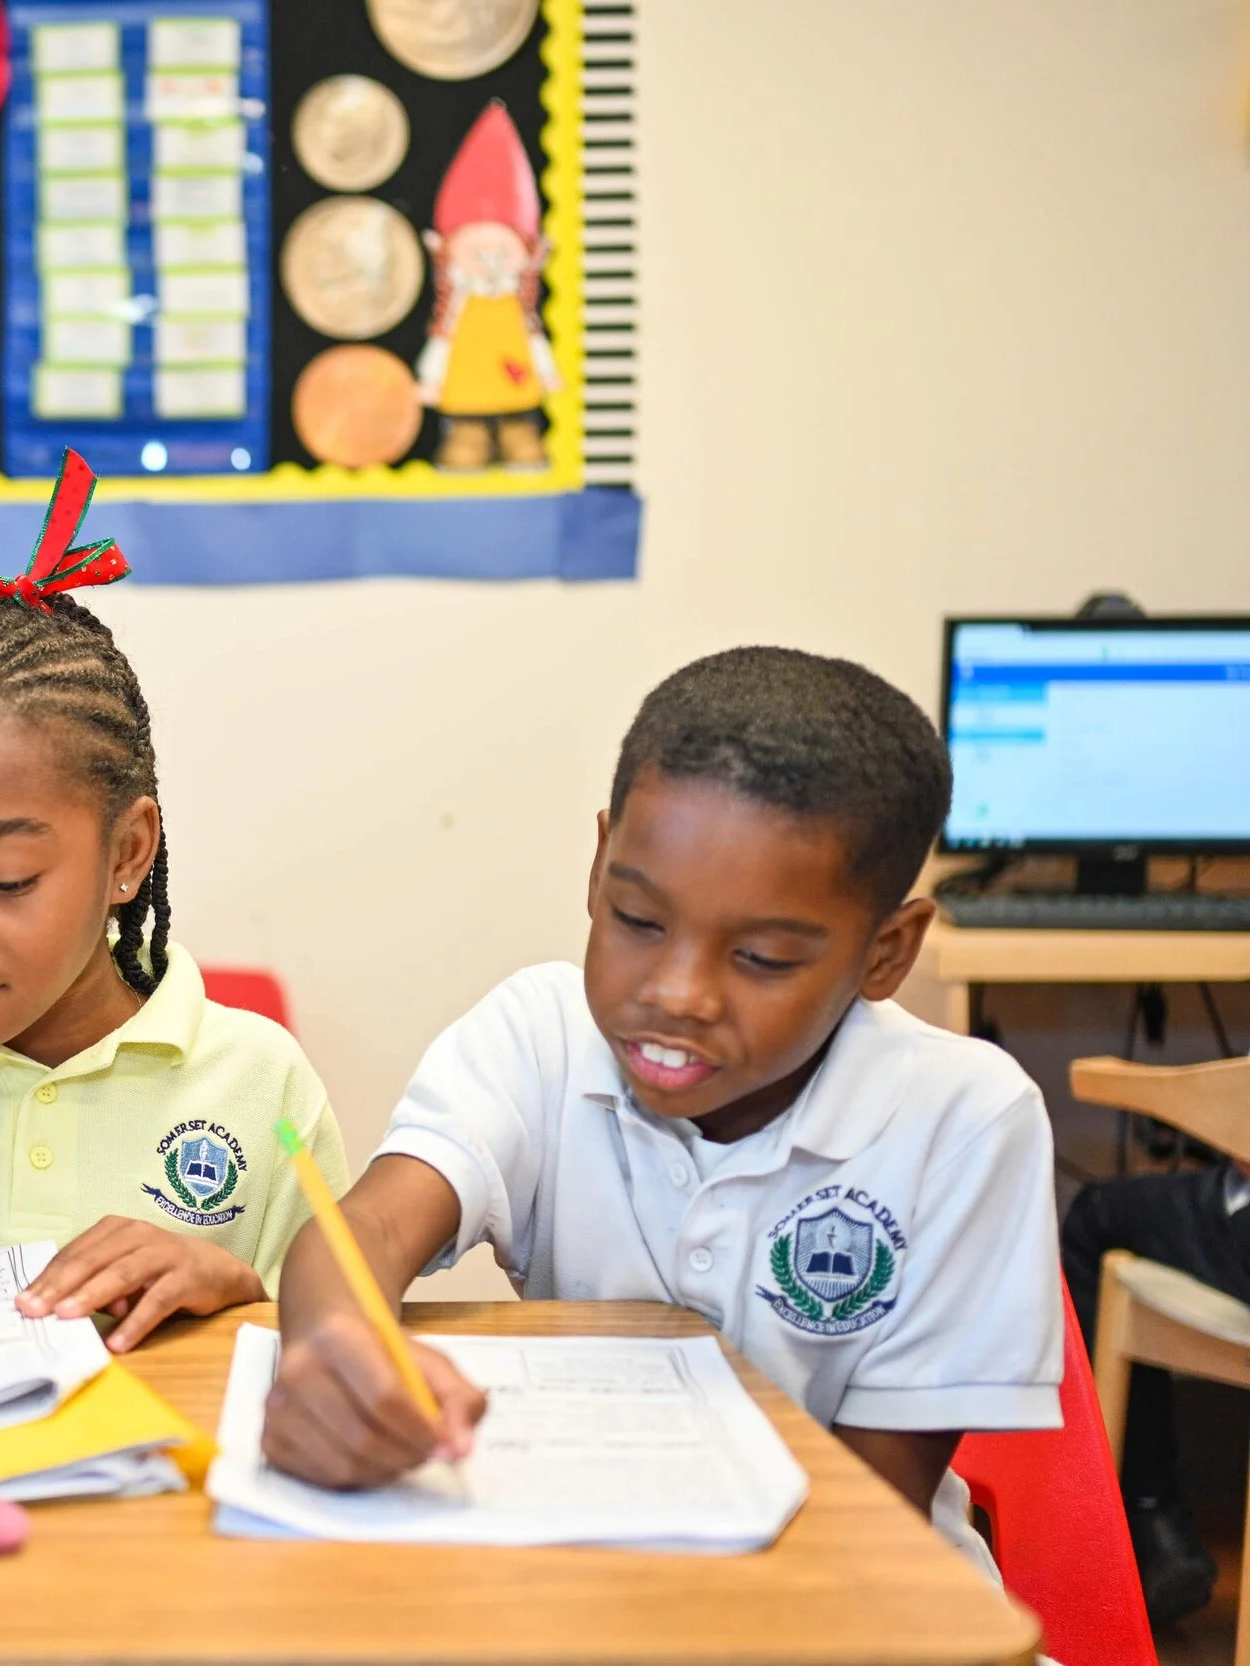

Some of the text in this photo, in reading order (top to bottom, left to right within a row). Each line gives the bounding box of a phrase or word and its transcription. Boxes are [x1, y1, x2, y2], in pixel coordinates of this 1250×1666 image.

[157, 1120, 247, 1171] SOMERSET ACADEMY
[156, 1196, 195, 1224] EXCELLENCE
[203, 1210, 233, 1225] EDUCATION
[768, 1185, 908, 1251] SOMERSET ACADEMY
[773, 1299, 886, 1333] EXCELLENCE IN EDUCATION
